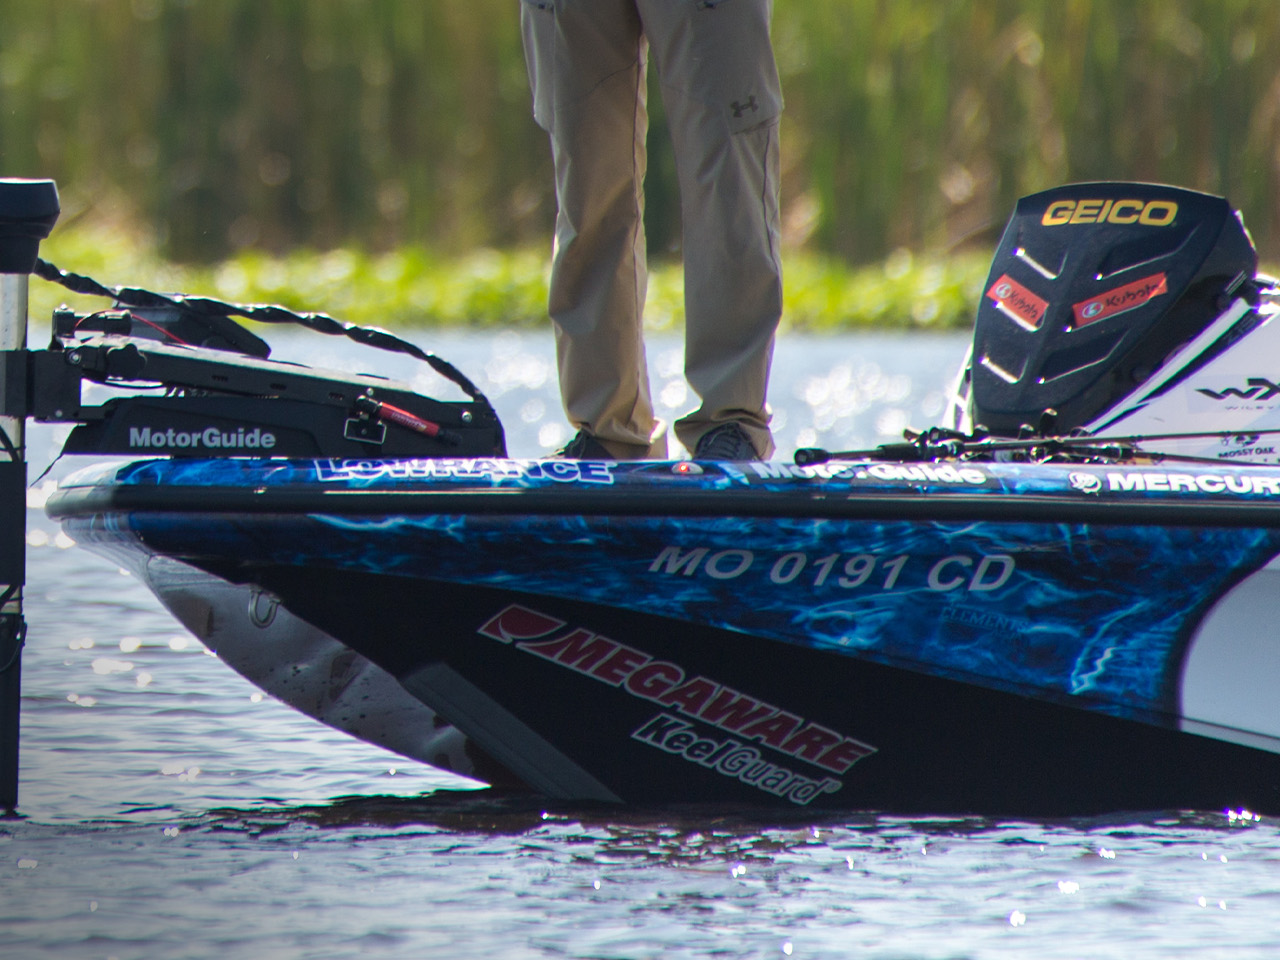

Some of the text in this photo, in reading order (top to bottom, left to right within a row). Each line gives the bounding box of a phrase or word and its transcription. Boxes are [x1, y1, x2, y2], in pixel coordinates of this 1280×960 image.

[1041, 200, 1178, 226] GEICO
[1009, 290, 1040, 319] Kubota
[129, 427, 276, 449] MotorGuide
[1218, 446, 1276, 459] MOSSY OAK
[314, 458, 618, 485] LOWRANCE
[1107, 472, 1280, 495] MERCUR
[648, 546, 1016, 592] MO 0191 CD
[516, 627, 879, 774] MEGAWARE
